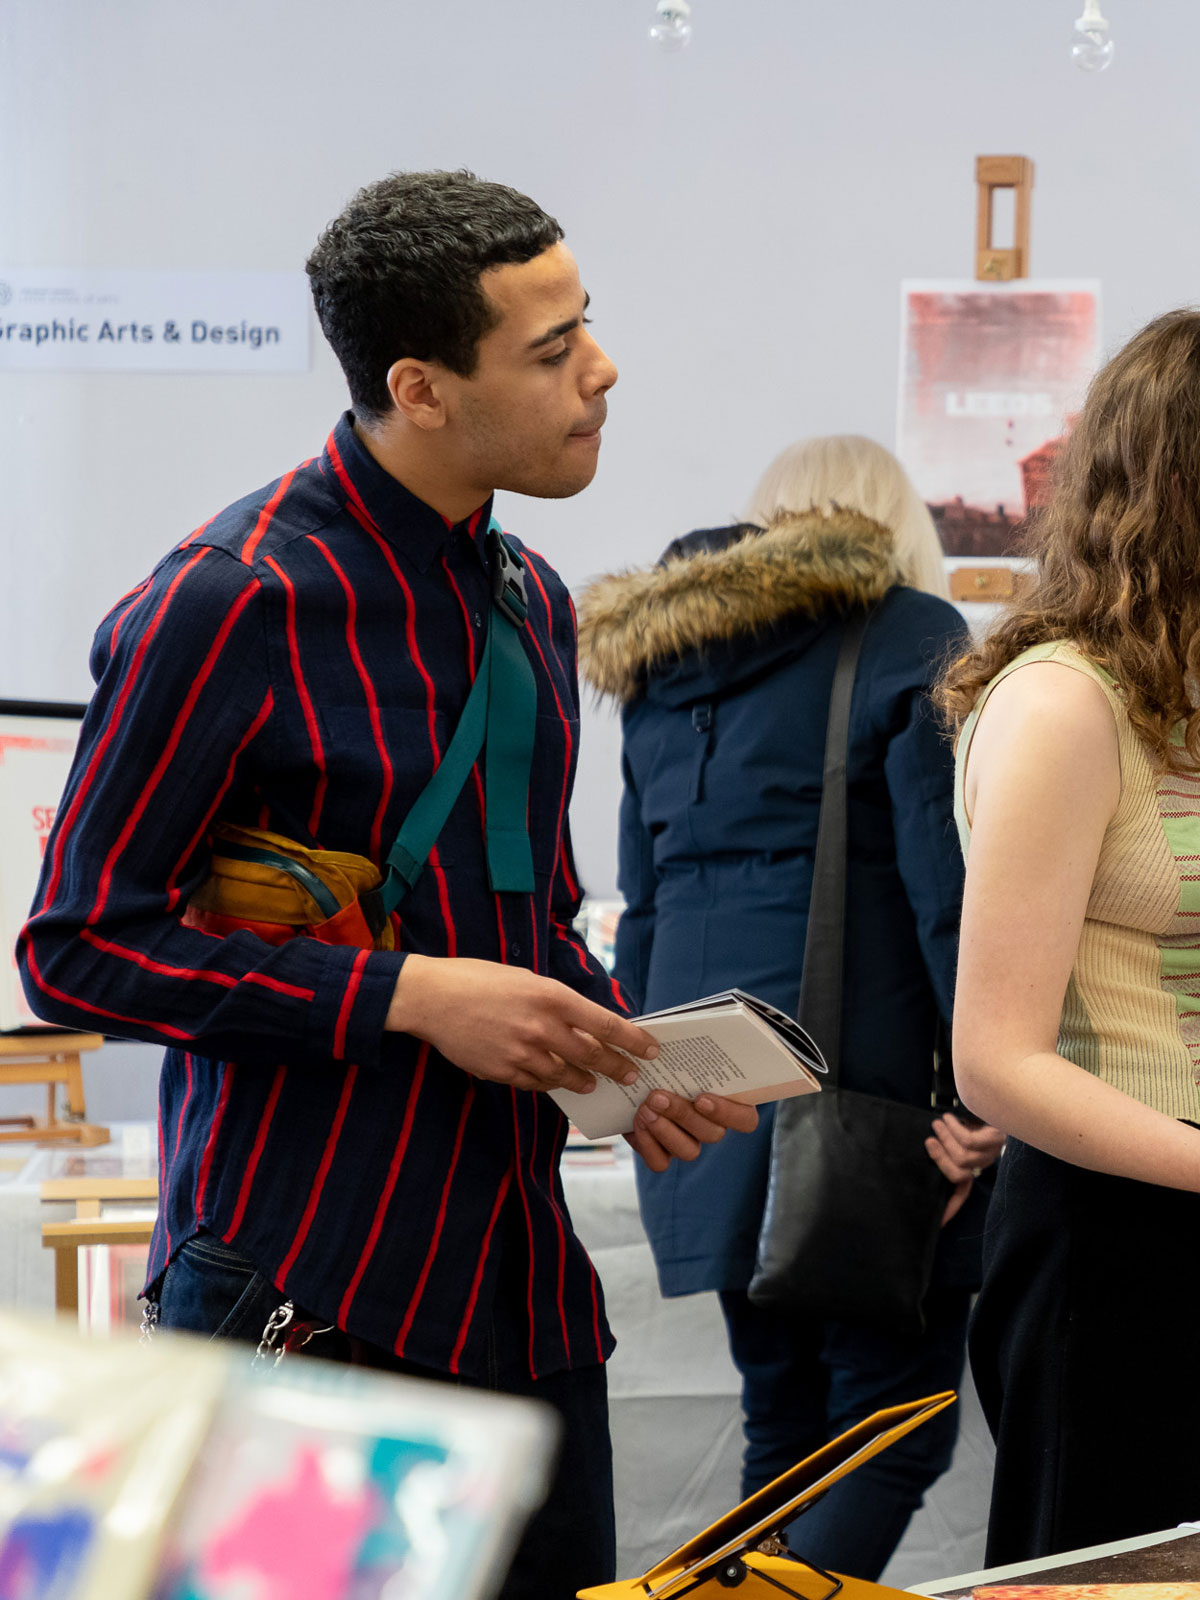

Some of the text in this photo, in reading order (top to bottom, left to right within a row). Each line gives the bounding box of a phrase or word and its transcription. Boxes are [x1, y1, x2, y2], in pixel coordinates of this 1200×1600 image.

[0, 318, 280, 349] raphic Arts & Design
[944, 391, 1053, 416] LEEDS
